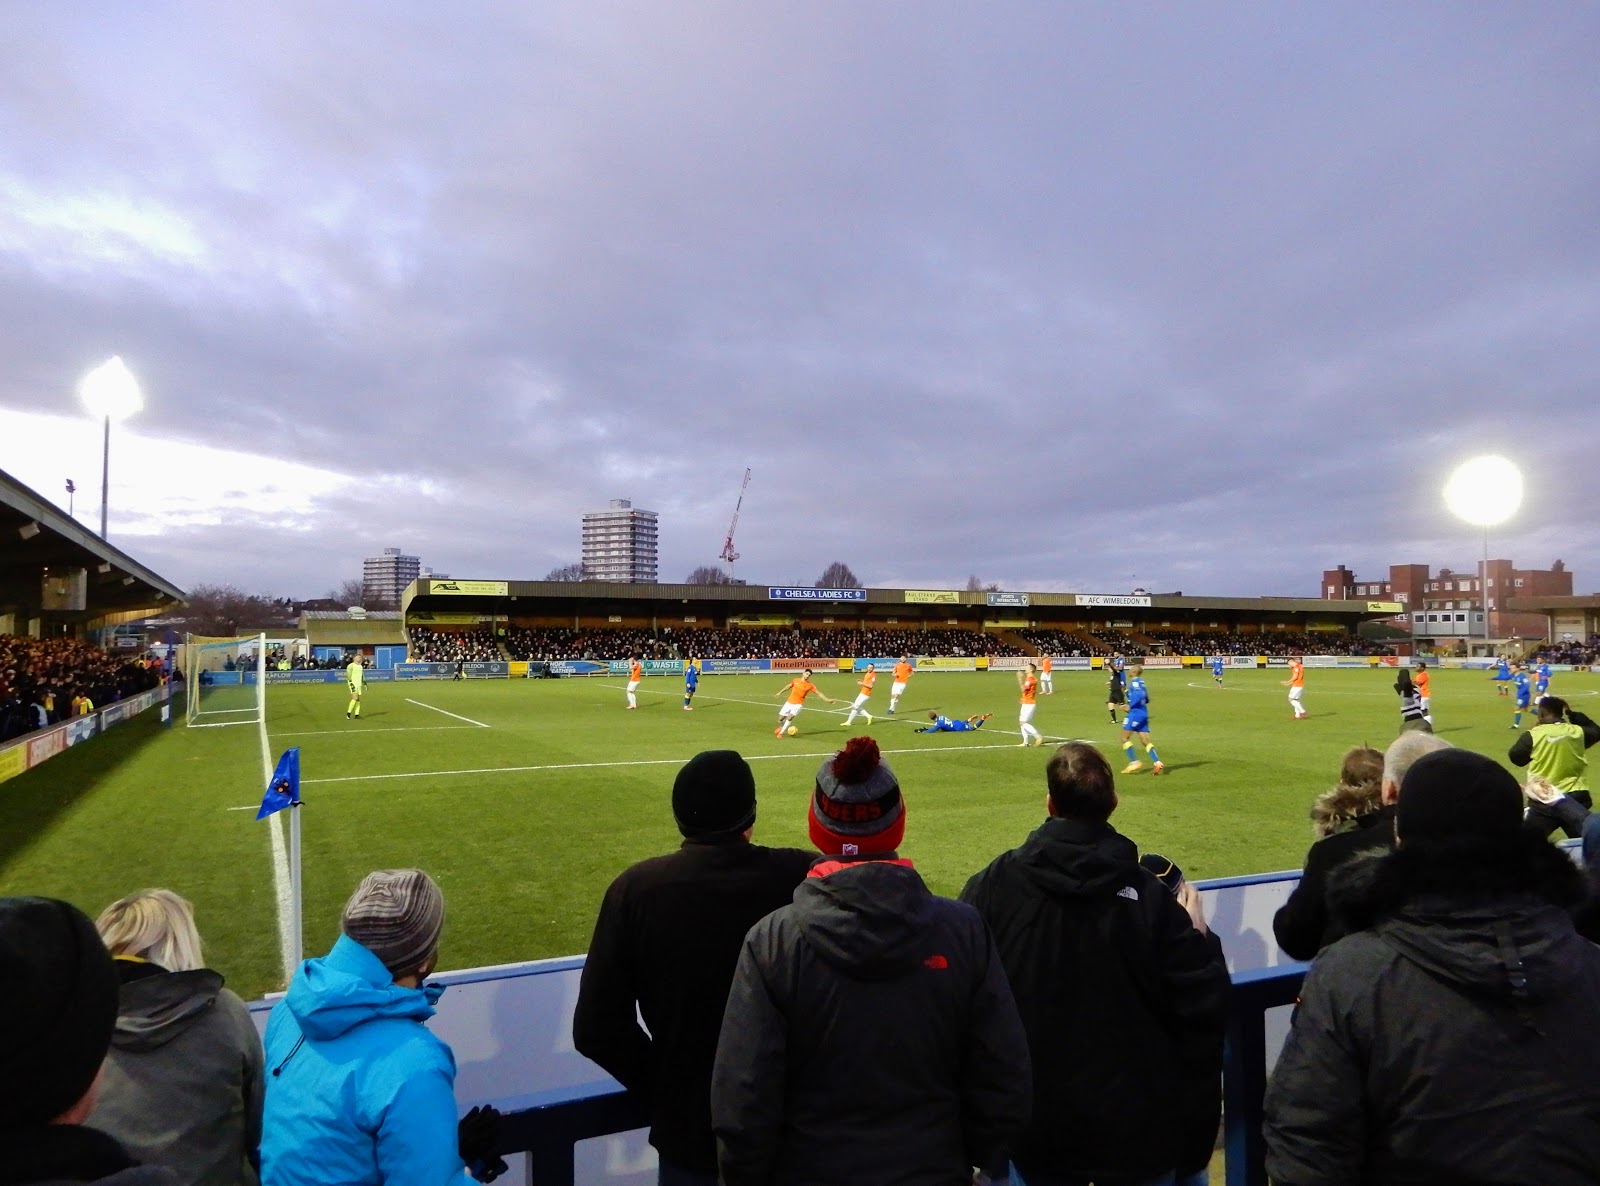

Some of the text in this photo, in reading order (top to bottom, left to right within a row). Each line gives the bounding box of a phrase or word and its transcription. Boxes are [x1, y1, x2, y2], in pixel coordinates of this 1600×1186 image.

[785, 590, 853, 599] CHELSEA LADIES FC
[613, 661, 679, 669] RESN WASTE
[1144, 657, 1181, 665] CHERRYRED.CO.UK
